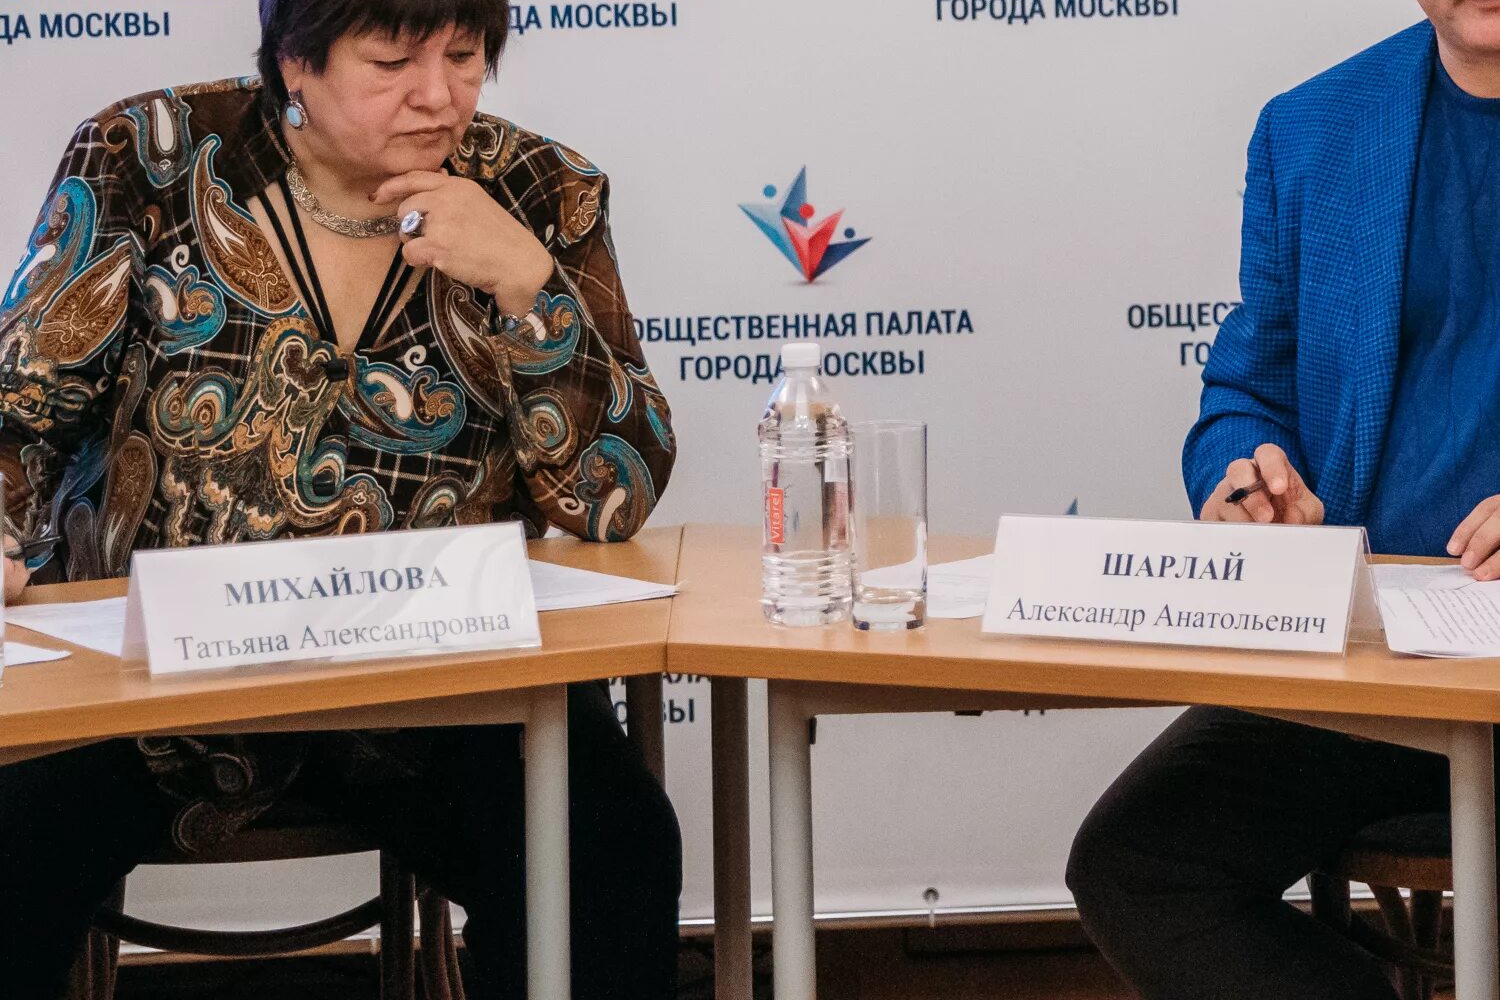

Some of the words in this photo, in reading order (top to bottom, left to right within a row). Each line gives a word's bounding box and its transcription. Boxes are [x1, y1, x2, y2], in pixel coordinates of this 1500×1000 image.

[39, 11, 170, 39] МОСКВЫ
[550, 2, 677, 29] МОСКВЫ
[634, 310, 857, 346] ОБЩЕСТВЕННАЯ
[865, 309, 974, 337] ПАЛАТА
[819, 350, 925, 377] ОСКВЫ
[770, 492, 780, 539] Vitarel
[1102, 551, 1246, 581] ШАРЛАЙ
[225, 566, 449, 606] МИХАЙЛОВА
[1007, 597, 1145, 632] Александр
[1153, 604, 1326, 634] Анатольевич
[176, 634, 289, 662] Татьяна
[299, 611, 511, 650] Александровна
